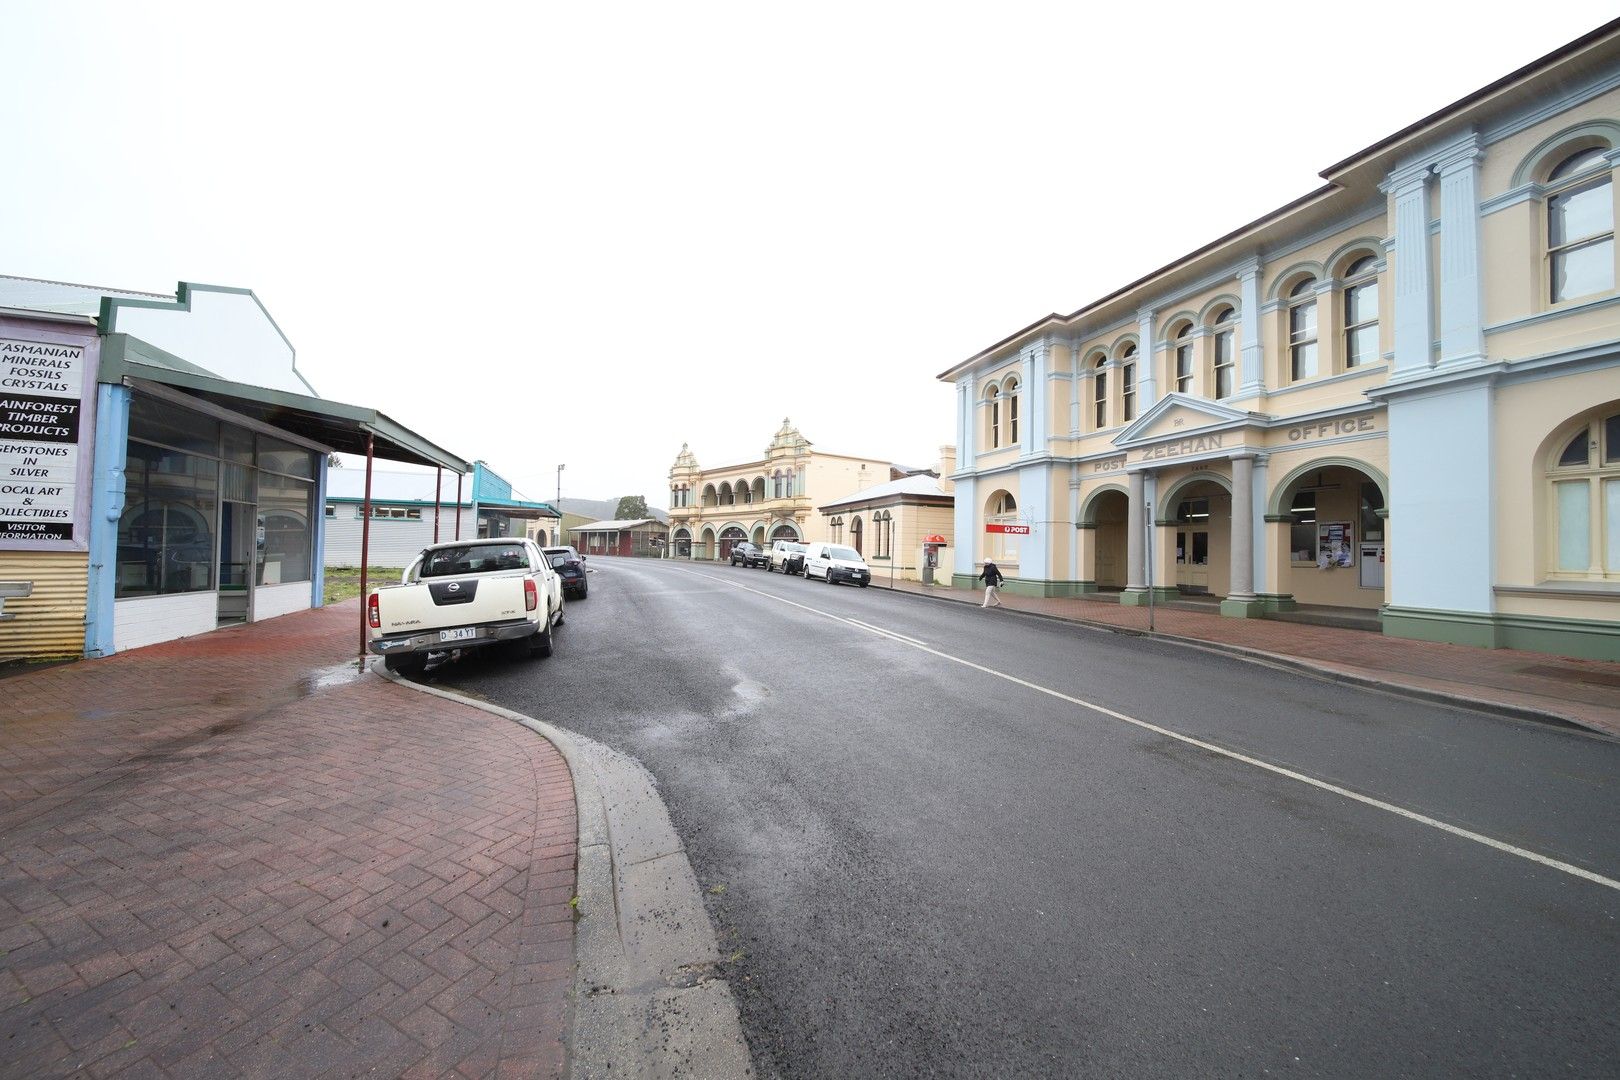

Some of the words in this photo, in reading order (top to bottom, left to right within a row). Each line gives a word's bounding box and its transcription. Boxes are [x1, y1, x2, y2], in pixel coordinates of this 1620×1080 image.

[0, 342, 80, 359] ASMANIAN
[2, 355, 71, 369] MINERALS
[9, 367, 62, 380] FOSSILS
[2, 378, 68, 392] CRYSTALS
[0, 400, 77, 414] AINFOREST
[7, 412, 58, 424] TIMBER
[1288, 415, 1375, 441] OFFICE
[1142, 435, 1223, 460] ZEEHAN
[22, 457, 38, 466] IN
[1094, 459, 1127, 473] POST
[9, 467, 49, 478] SILVER
[1, 485, 35, 495] OCAL
[38, 487, 63, 496] ART
[22, 497, 34, 506] &
[0, 507, 69, 518] OLLECTIBLES
[7, 523, 46, 532] VISITOR
[0, 531, 62, 540] FORMATION
